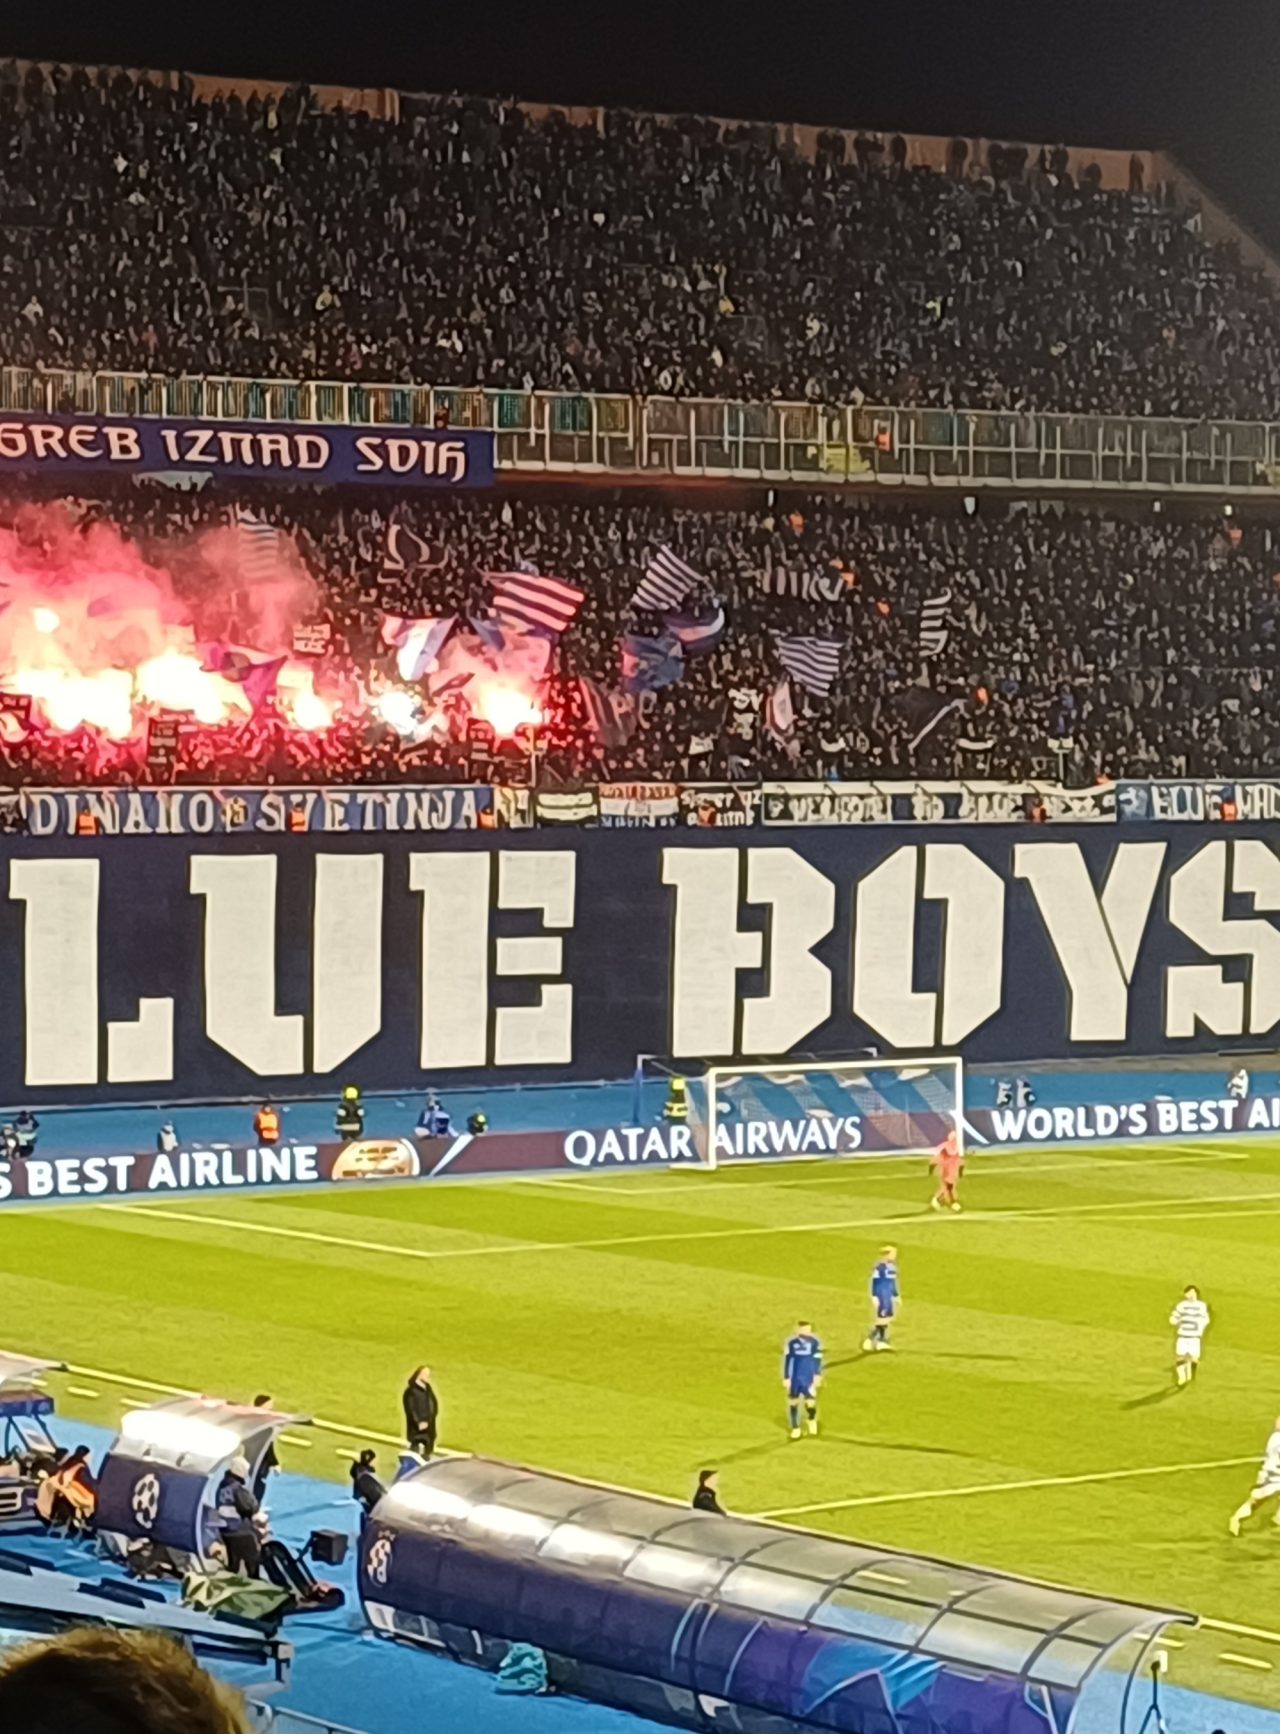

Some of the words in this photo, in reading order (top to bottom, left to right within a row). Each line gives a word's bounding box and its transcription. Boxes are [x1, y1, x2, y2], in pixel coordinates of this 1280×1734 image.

[0, 422, 142, 460] GREB
[8, 850, 576, 1086] LUE
[563, 1124, 693, 1166] QATAR
[712, 1115, 863, 1156] AIRWAYS
[991, 1101, 1148, 1142] WORLD'S
[1157, 1098, 1240, 1134] BEST
[26, 1155, 136, 1197] BEST
[147, 1145, 319, 1190] AIRLINE
